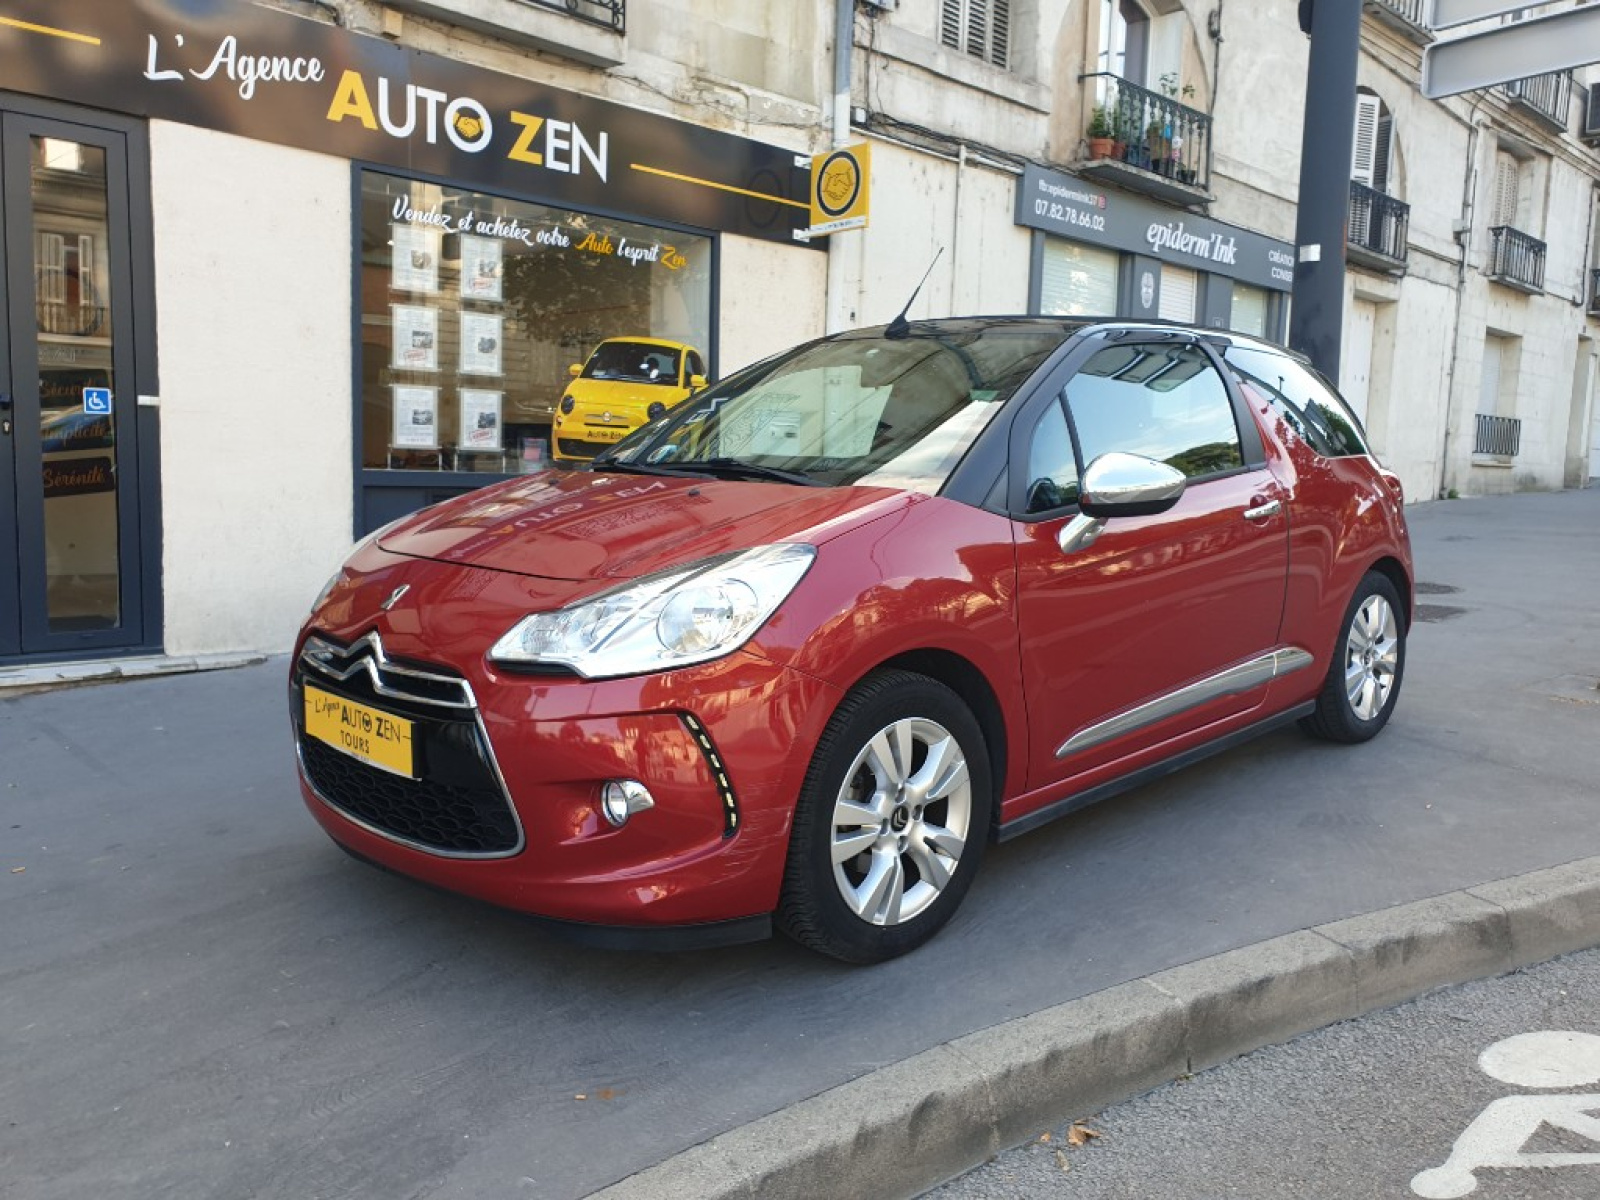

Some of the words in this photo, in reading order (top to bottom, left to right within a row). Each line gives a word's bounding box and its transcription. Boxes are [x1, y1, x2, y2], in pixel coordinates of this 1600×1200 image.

[189, 35, 326, 100] Agence
[326, 69, 493, 153] AUTO
[507, 110, 608, 184] ZEN
[392, 194, 459, 233] Vendez
[457, 210, 474, 231] et
[475, 216, 534, 247] achetez
[535, 226, 571, 248] votre
[574, 232, 614, 255] Auto
[660, 246, 688, 270] Zen
[1035, 199, 1106, 231] 07.82.78.66.02
[1146, 221, 1238, 265] epiderm'Ink
[1268, 249, 1295, 267] CRÉATIO
[340, 729, 370, 754] TOURS
[341, 704, 373, 733] AUTO
[375, 716, 401, 743] ZEN
